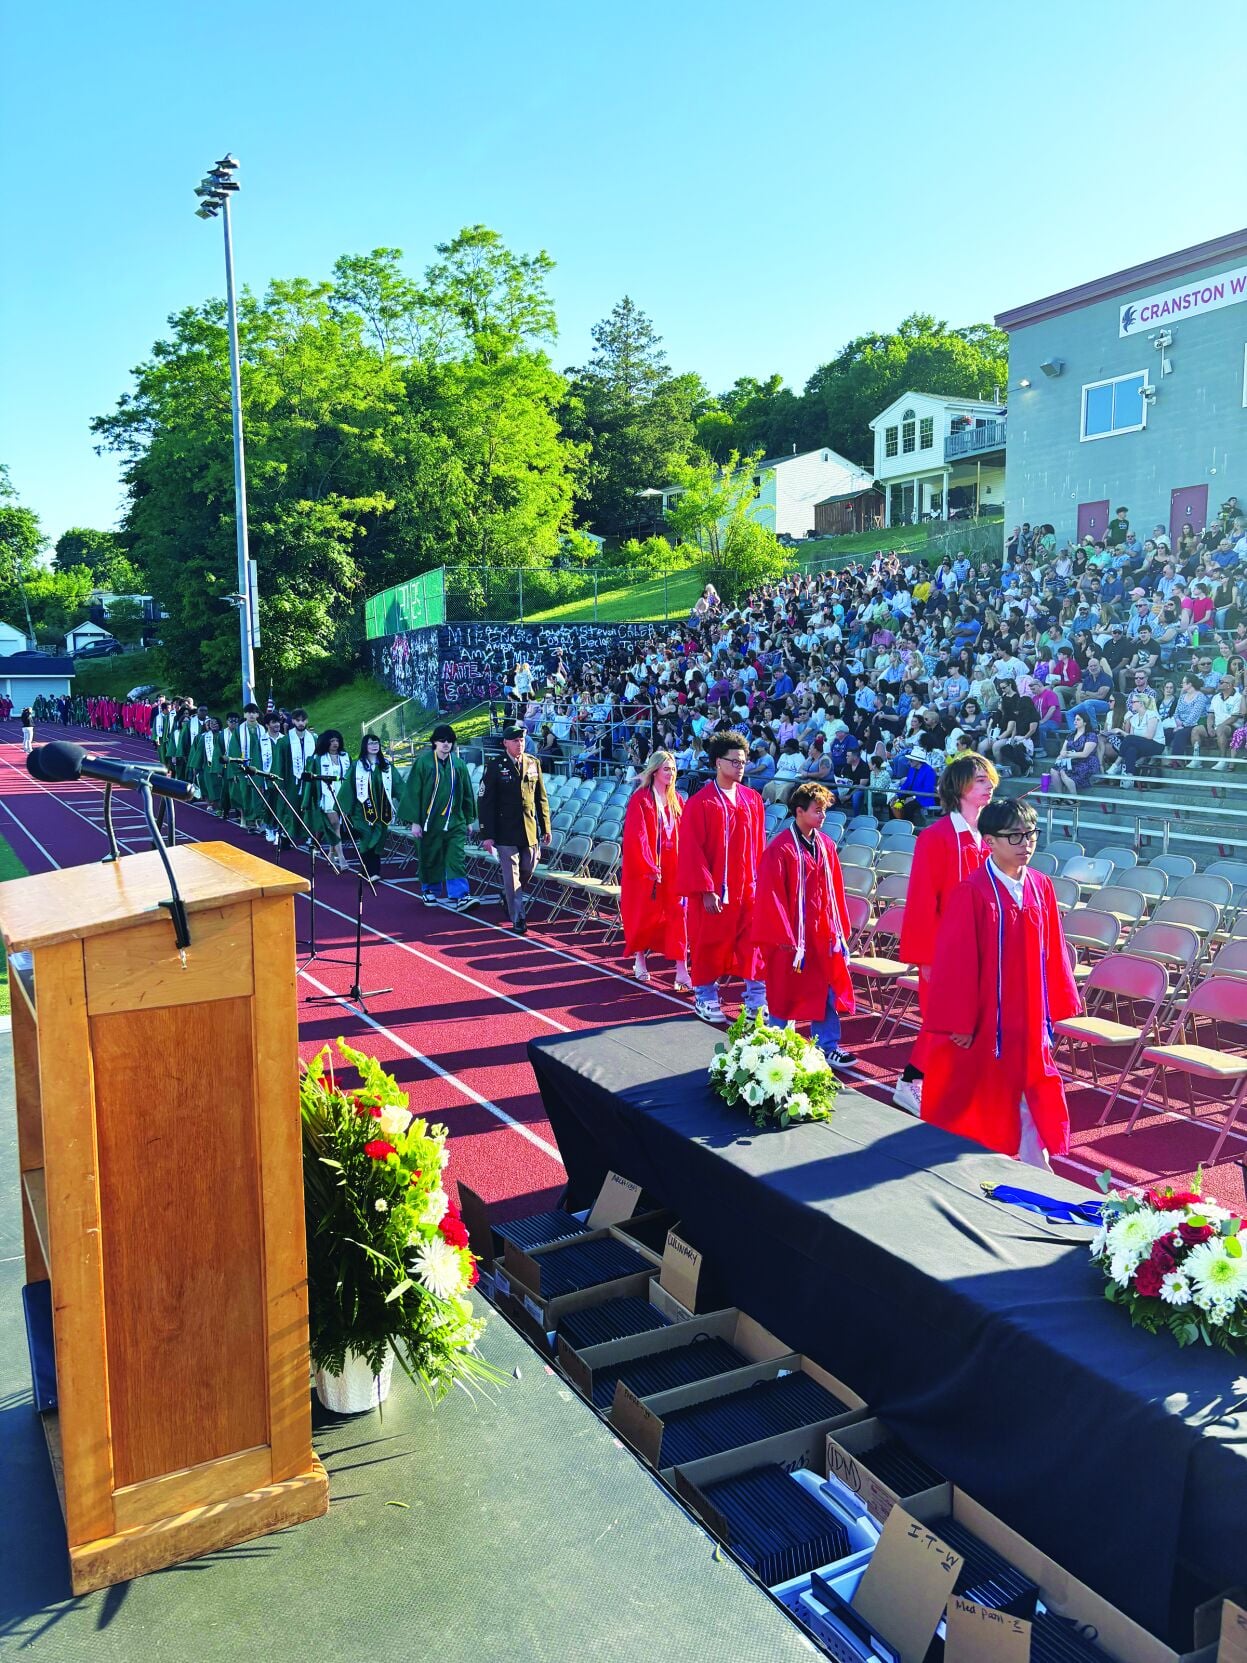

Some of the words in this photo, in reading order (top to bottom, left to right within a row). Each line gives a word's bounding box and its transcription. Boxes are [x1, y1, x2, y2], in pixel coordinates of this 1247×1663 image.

[1140, 283, 1224, 322] CRANSTON
[1230, 275, 1247, 295] W
[667, 1233, 697, 1266] CULINARY
